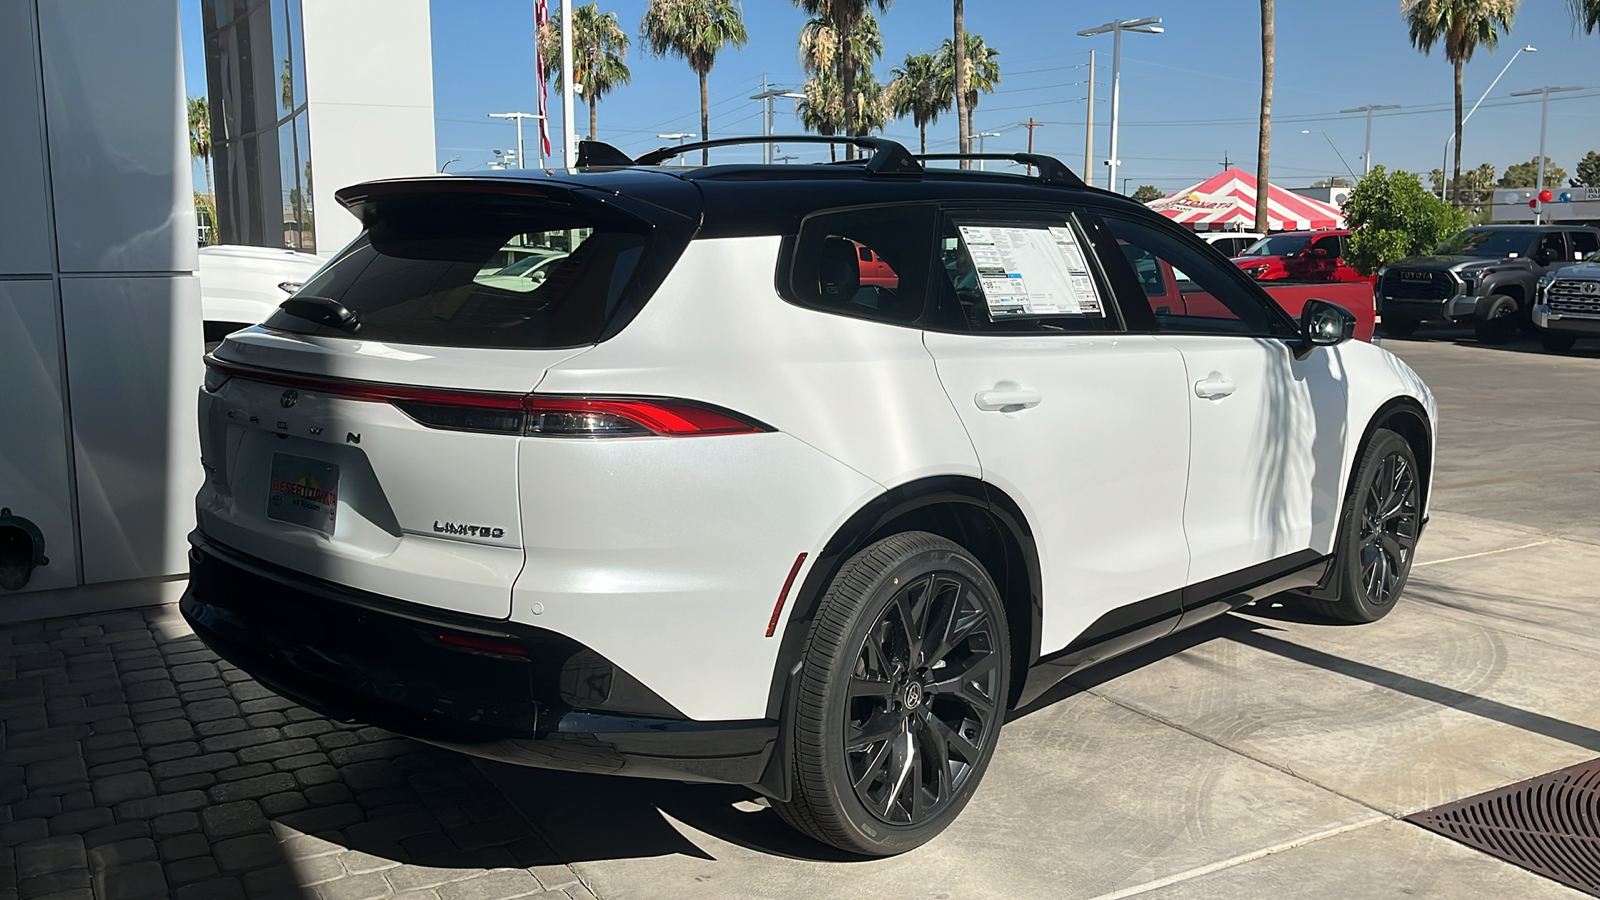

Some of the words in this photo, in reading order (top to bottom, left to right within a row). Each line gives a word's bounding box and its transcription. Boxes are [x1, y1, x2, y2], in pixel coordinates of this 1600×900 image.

[1400, 270, 1433, 279] TOYOTA
[227, 410, 361, 445] CROWN
[272, 479, 307, 498] DESERT
[309, 486, 337, 507] TOYOTA
[433, 520, 504, 538] LIMITED
